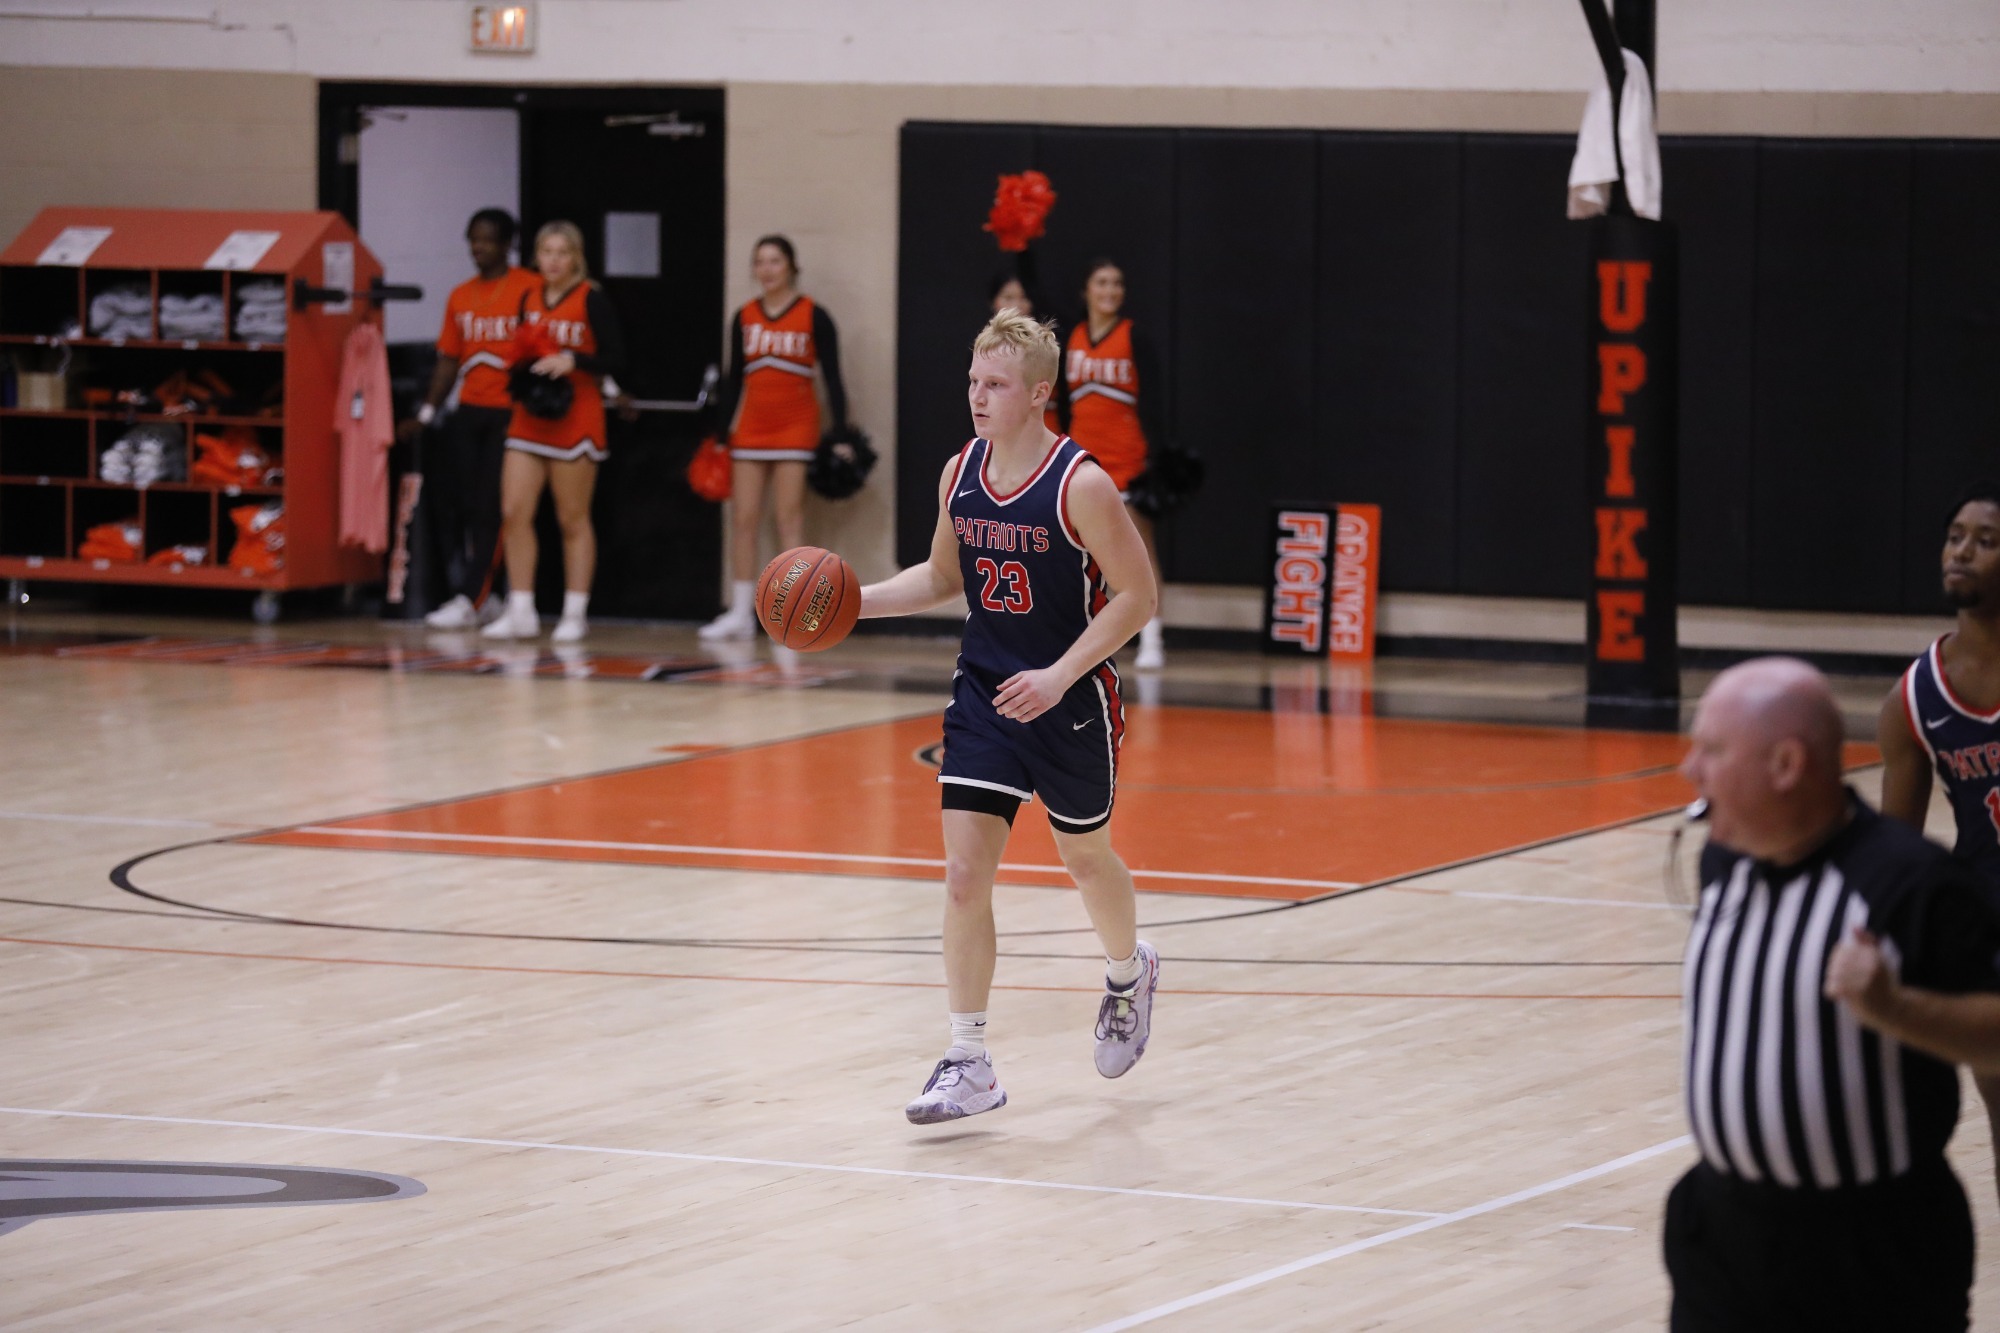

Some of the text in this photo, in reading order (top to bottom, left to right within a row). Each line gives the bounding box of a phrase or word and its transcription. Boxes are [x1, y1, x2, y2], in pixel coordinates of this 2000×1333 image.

[1596, 261, 1651, 661] UPIKE
[954, 516, 1050, 552] PATRIOTS
[769, 558, 812, 626] SPALDING
[795, 574, 829, 632] LEGACY
[975, 556, 1034, 614] 23
[1271, 511, 1329, 652] FIGHT
